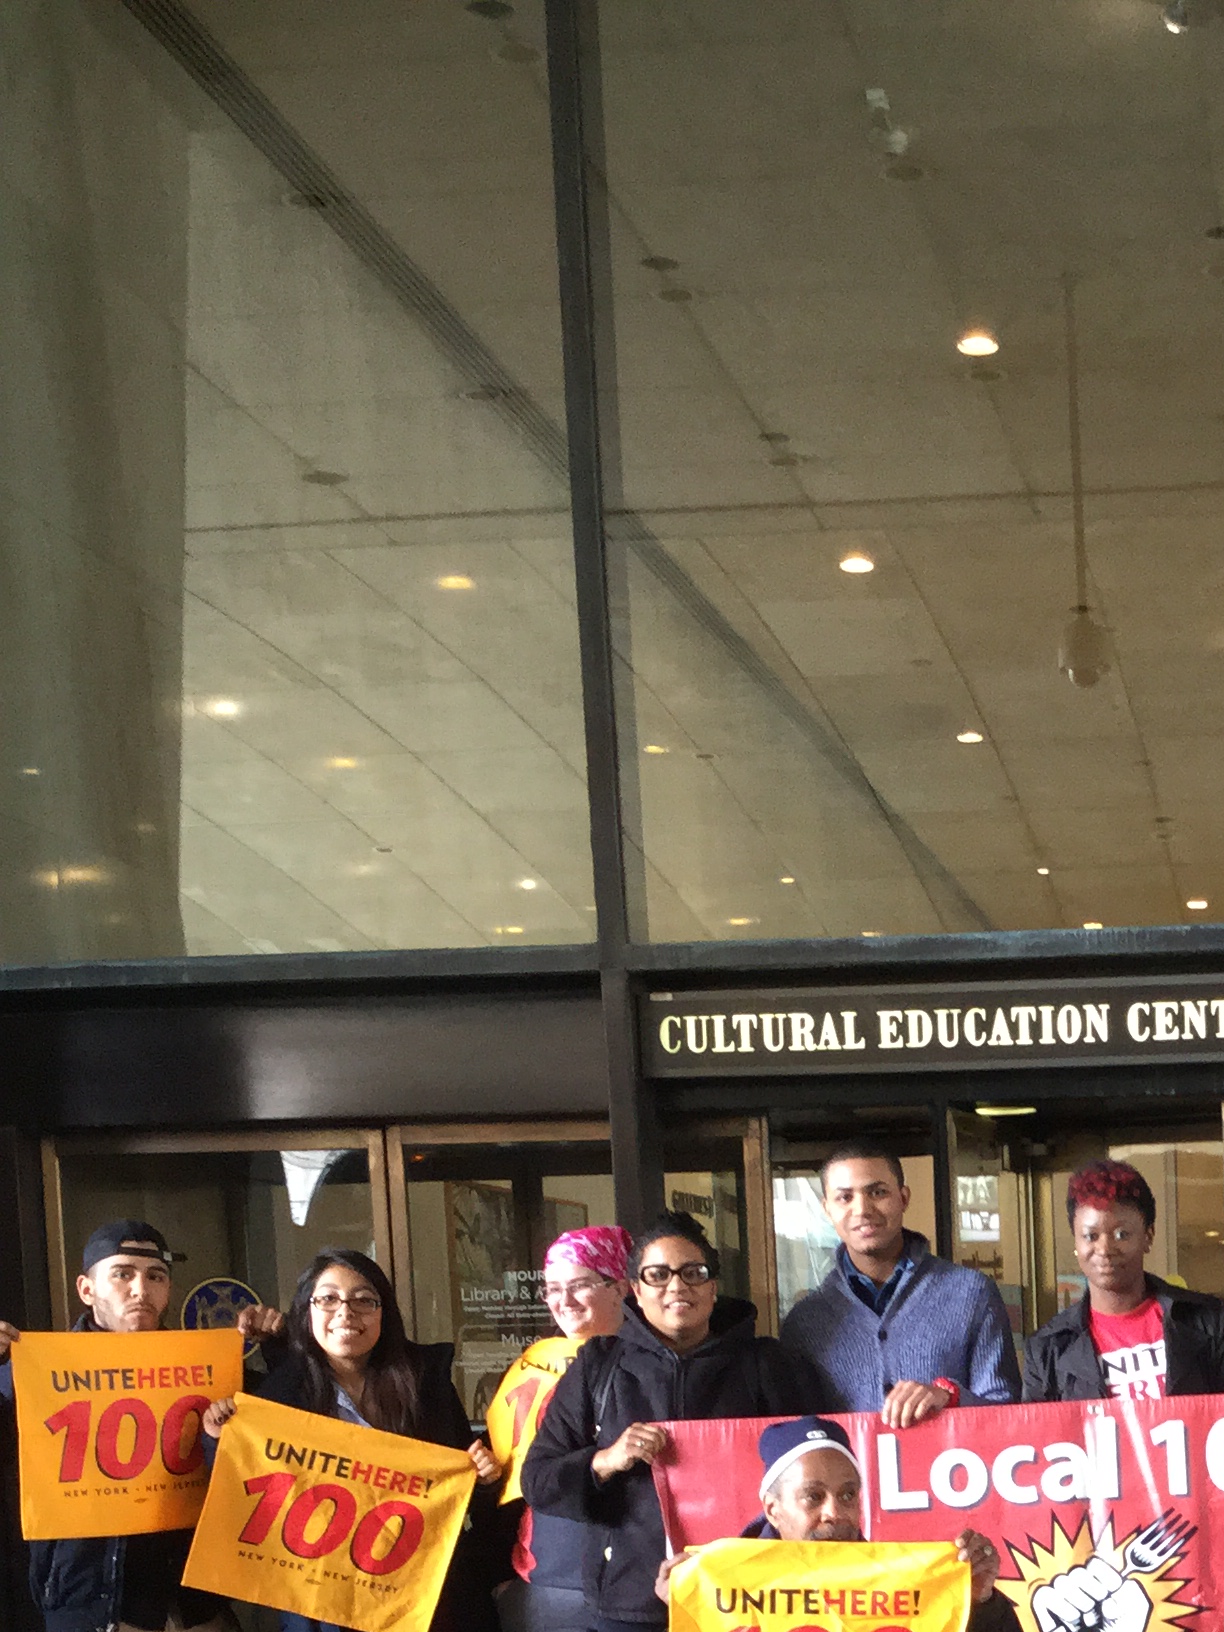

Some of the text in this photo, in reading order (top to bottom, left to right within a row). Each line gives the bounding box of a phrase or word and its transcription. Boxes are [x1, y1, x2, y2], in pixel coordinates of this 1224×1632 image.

[658, 1010, 866, 1054] CULTURAL
[876, 1003, 1111, 1049] EDUCATION
[461, 1287, 516, 1303] Library
[50, 1364, 214, 1393] UNITEHERE!
[44, 1395, 212, 1483] 100
[265, 1438, 434, 1499] UNITEHERE!
[875, 1414, 1122, 1512] Local
[95, 1487, 129, 1497] YORK
[238, 1472, 425, 1577] 100
[271, 1556, 305, 1572] YORK
[715, 1587, 922, 1617] UNITEHERE!
